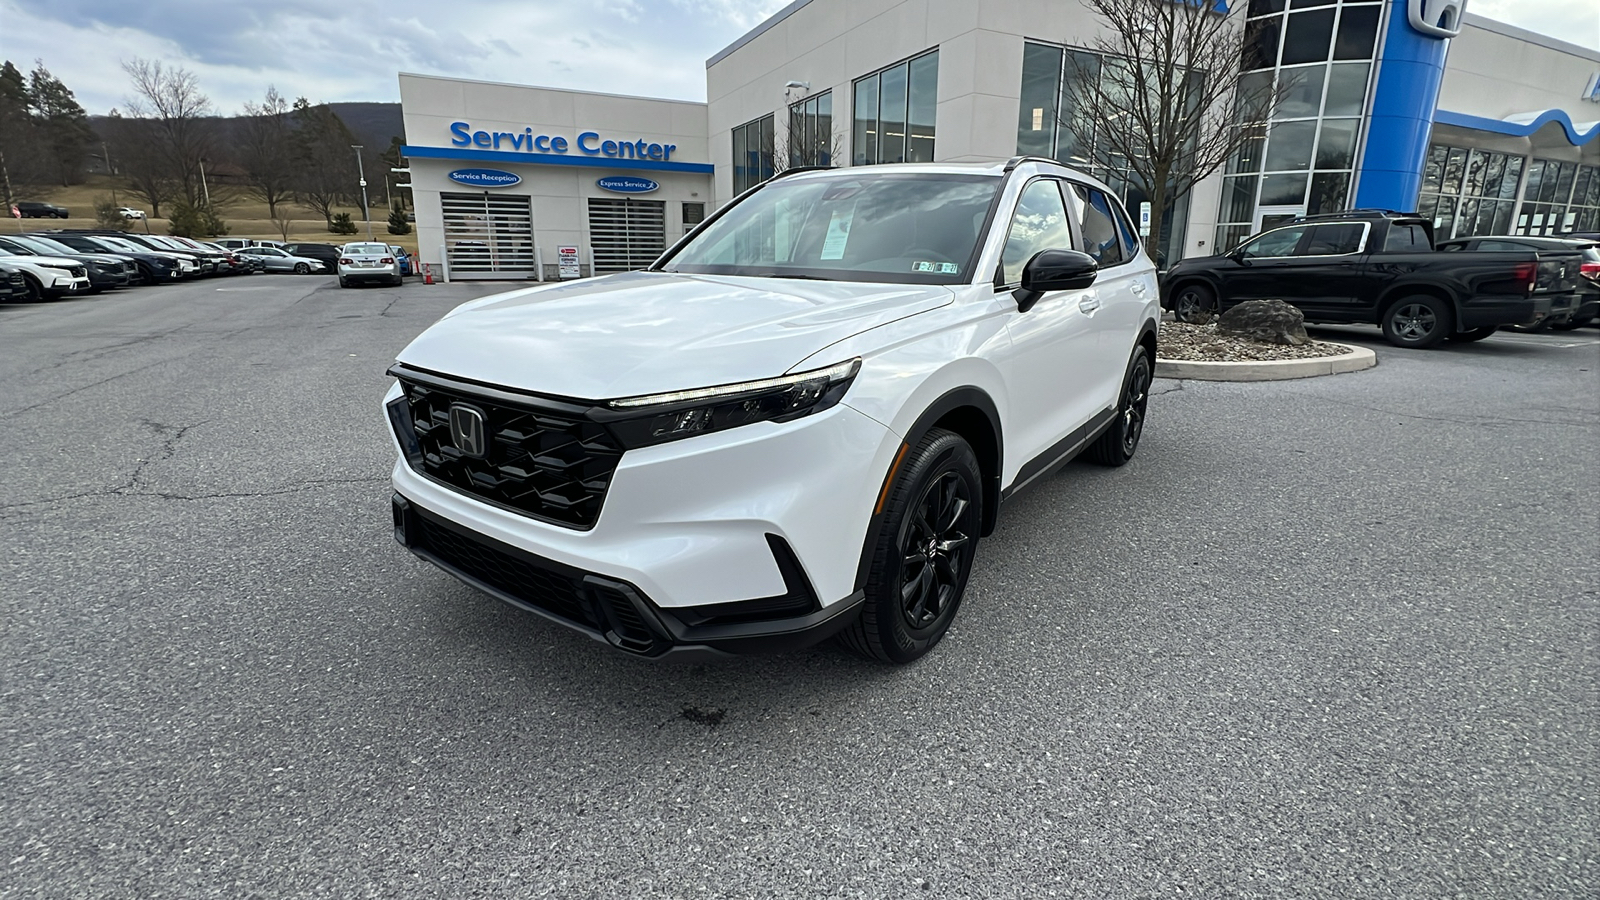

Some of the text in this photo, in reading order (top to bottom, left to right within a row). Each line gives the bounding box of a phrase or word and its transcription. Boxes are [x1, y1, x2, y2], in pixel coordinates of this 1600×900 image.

[450, 122, 676, 160] Service Center
[453, 172, 517, 182] Service Reception
